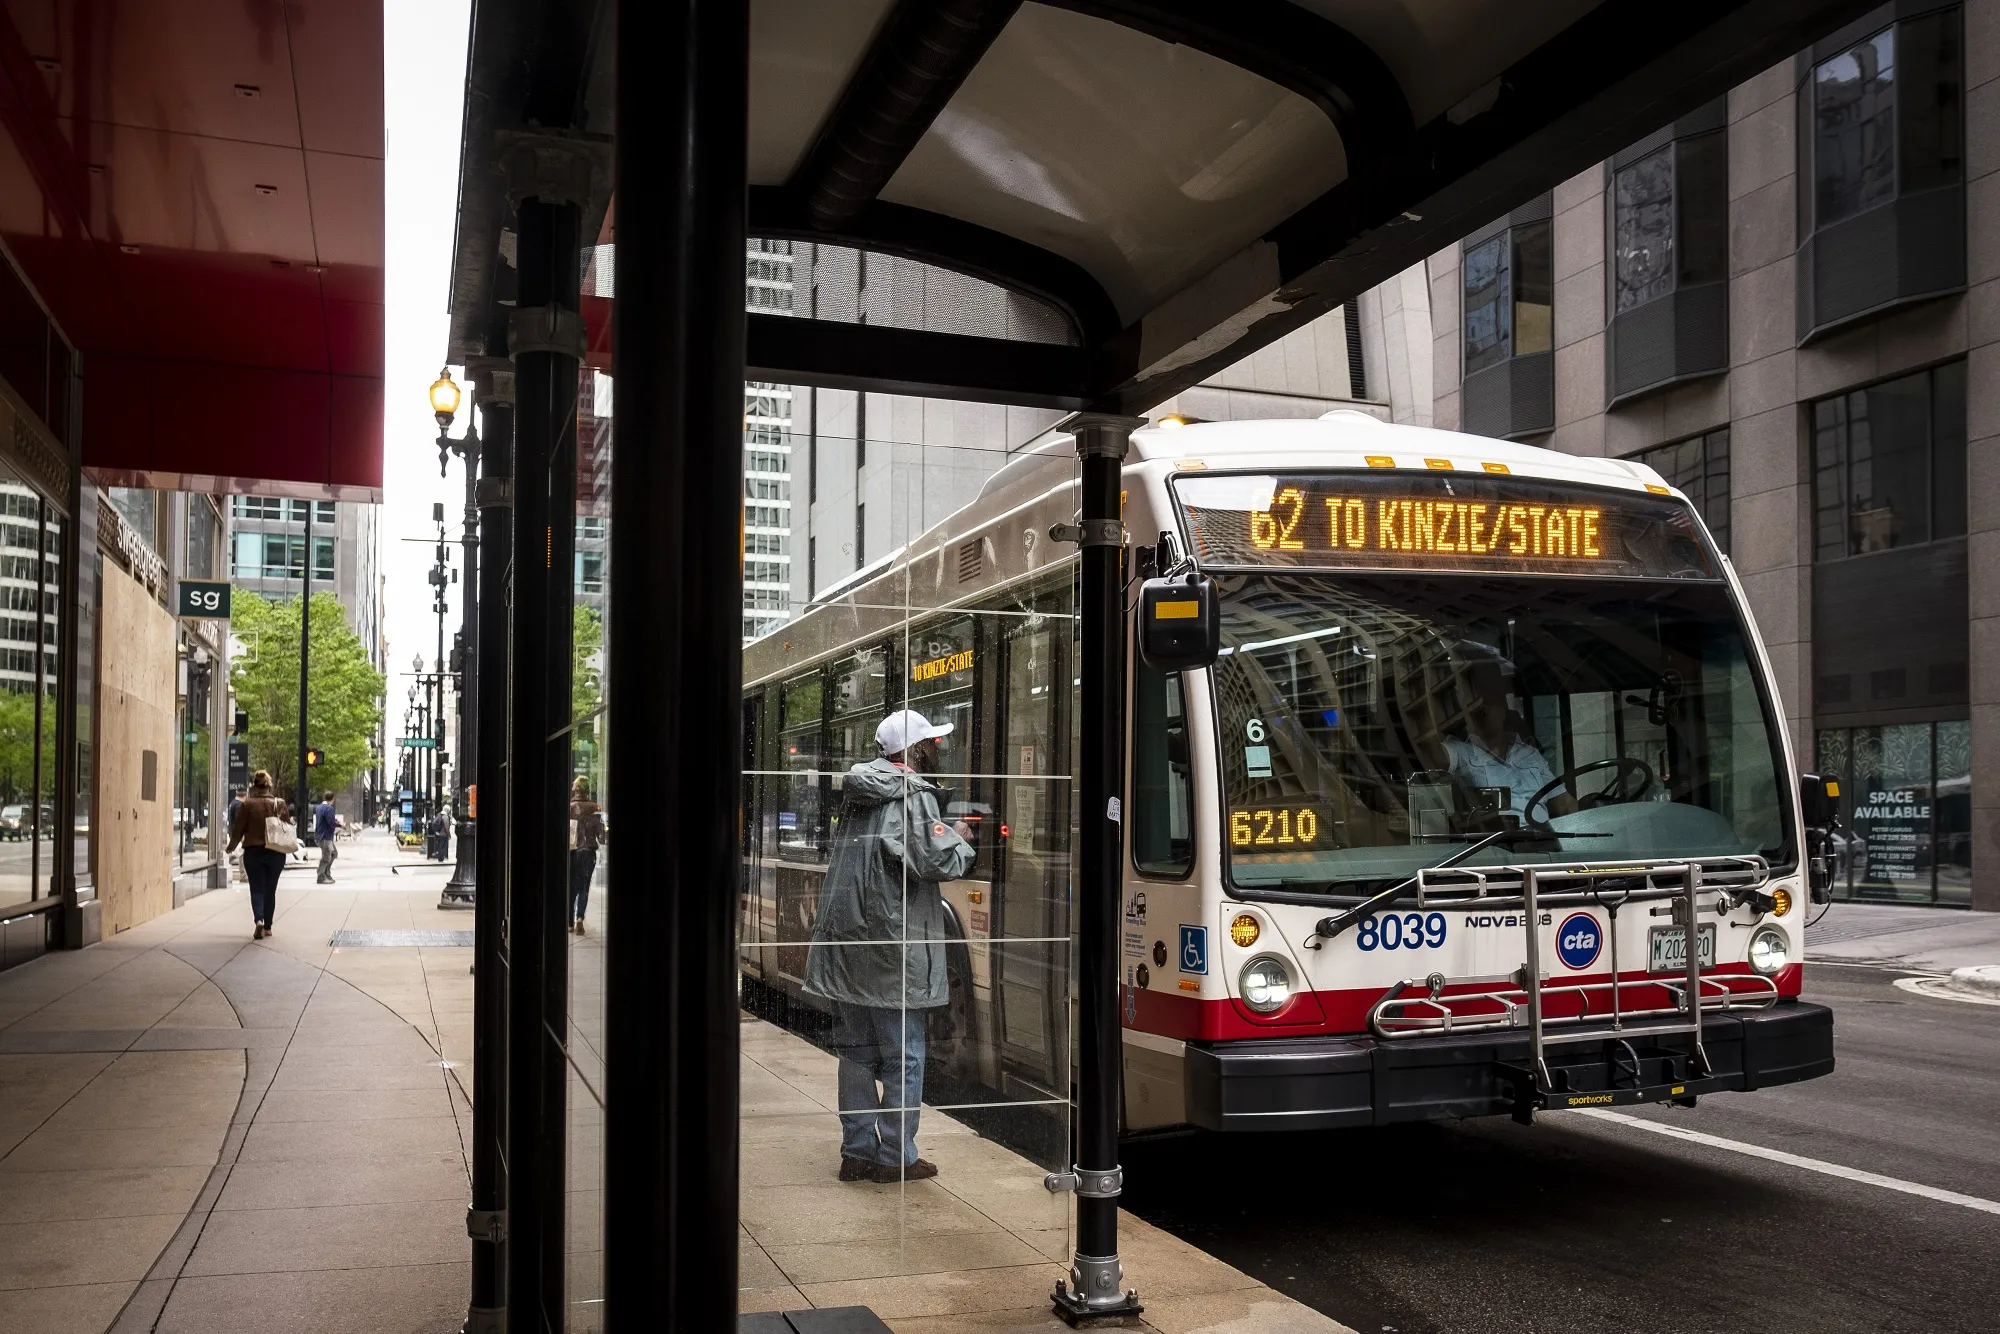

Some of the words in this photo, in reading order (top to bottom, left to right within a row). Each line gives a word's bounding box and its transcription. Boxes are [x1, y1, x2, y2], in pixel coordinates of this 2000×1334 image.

[1250, 488, 1304, 549] 62
[1326, 497, 1366, 549] TO
[1379, 501, 1601, 556] KINZIE/STATE
[189, 590, 220, 610] sg
[913, 665, 922, 682] TO
[923, 650, 974, 680] KINZIE/STATE
[1246, 718, 1265, 743] 6
[1869, 791, 1914, 804] SPACE
[1854, 806, 1931, 819] AVAILABLE
[1230, 808, 1317, 845] 6210
[1356, 912, 1447, 952] 8039
[1563, 931, 1596, 950] cta
[1653, 939, 1662, 960] M
[1665, 936, 1710, 960] 20220
[1567, 1094, 1613, 1106] sportworks
